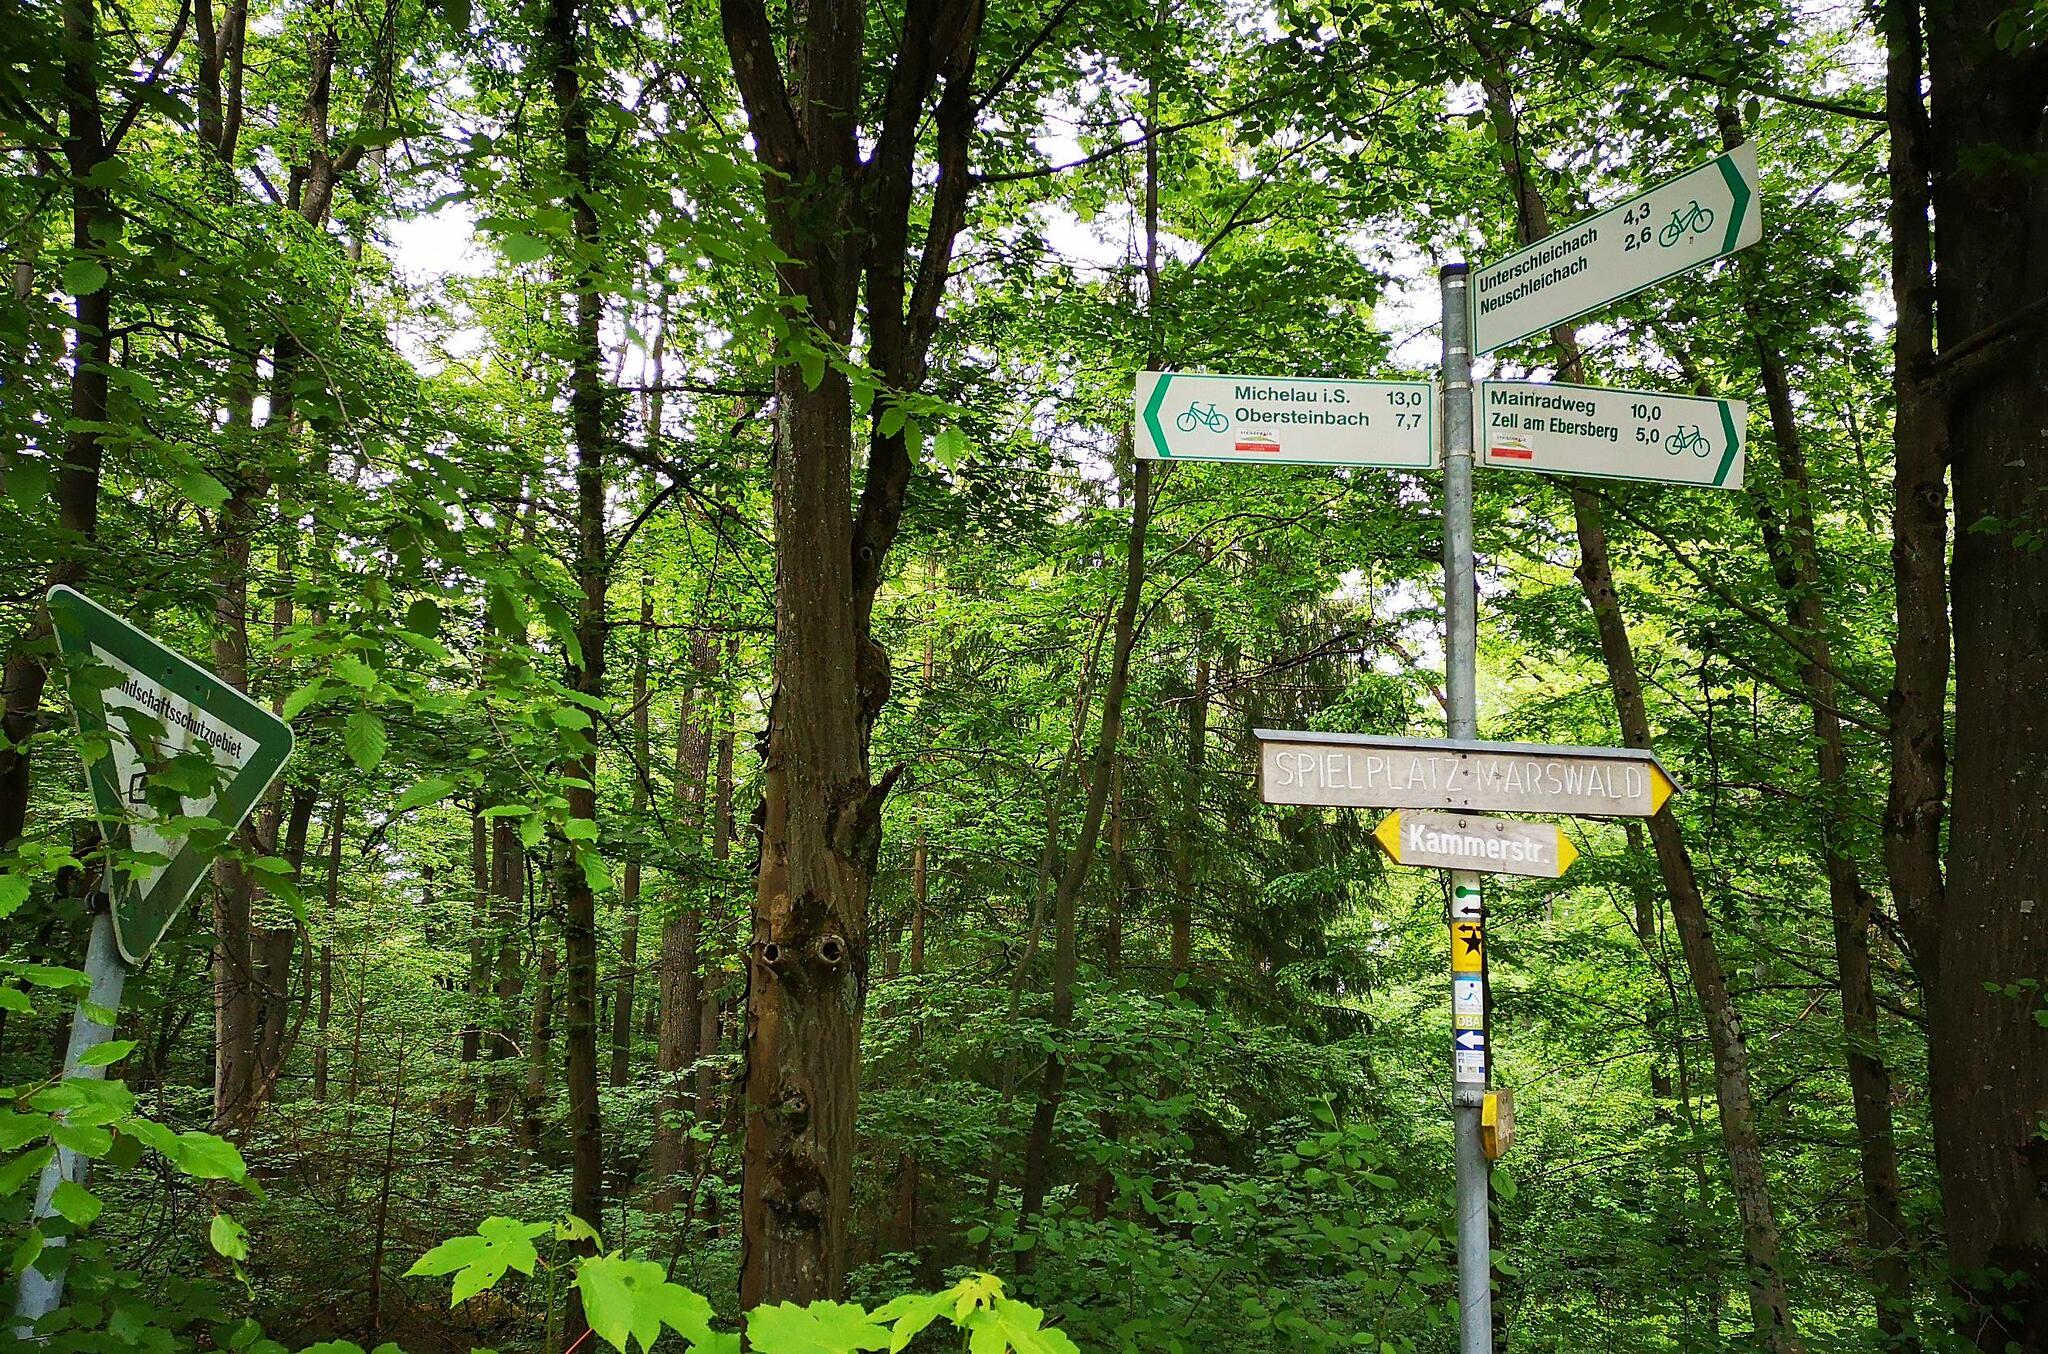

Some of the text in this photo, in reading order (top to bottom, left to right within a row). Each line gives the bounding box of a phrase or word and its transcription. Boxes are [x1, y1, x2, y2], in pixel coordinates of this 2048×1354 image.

[1480, 202, 1651, 293] Unterschleichach 4,3
[1480, 227, 1652, 315] Neuschleichach 2,6
[1235, 386, 1422, 408] Michelau i.S. 13,0
[1491, 391, 1662, 422] Mainradweg 10,0
[1235, 407, 1422, 430] Obersteinbach 7,7
[1491, 412, 1660, 445] Zell am Ebersberg 5,0
[113, 678, 242, 760] ndschaftsschutzgebiet
[1275, 751, 1642, 799] SPIELPLATZ MARSWALD
[1408, 824, 1551, 864] Kammerstr.
